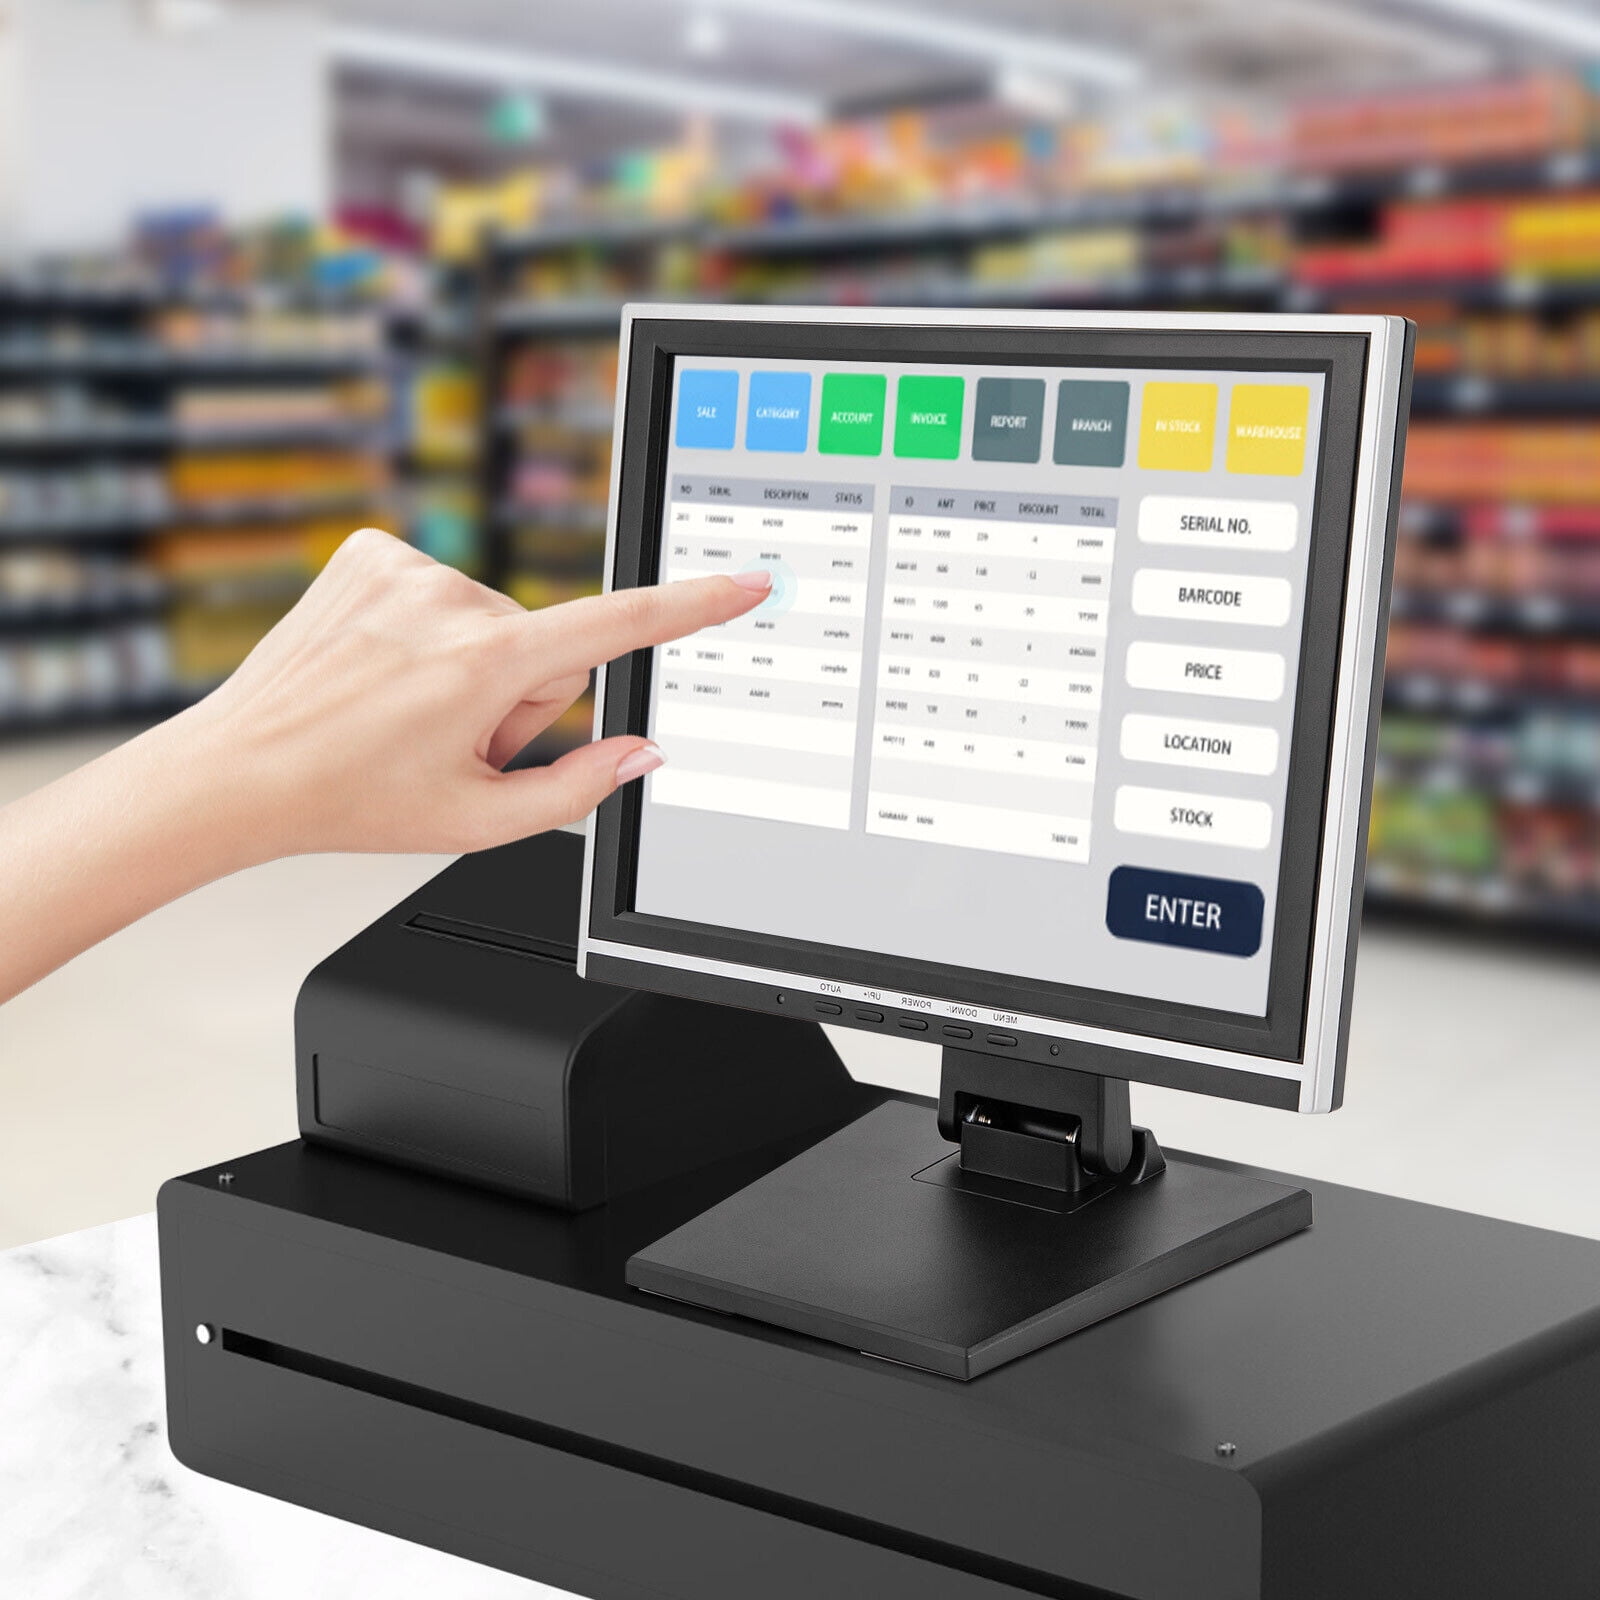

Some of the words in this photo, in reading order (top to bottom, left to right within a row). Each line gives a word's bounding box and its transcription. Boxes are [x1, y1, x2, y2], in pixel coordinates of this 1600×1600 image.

[697, 407, 716, 418] SALE
[756, 408, 799, 419] CATEGORY
[831, 412, 873, 424] ACCOUNT
[911, 413, 946, 424] INVOICE
[991, 416, 1027, 428] REPORT
[1072, 419, 1111, 431] BRANCH
[1236, 426, 1302, 440] WAREHOUSE
[681, 485, 692, 494] NO
[764, 489, 809, 500] DESCRIPTION
[835, 492, 862, 504] STATUS
[938, 499, 954, 508] AMT
[974, 501, 995, 512] PRICE
[1019, 503, 1058, 515] DISCOUNT
[1081, 507, 1104, 517] TOTAL
[1181, 516, 1224, 532] SERIAL
[1228, 518, 1251, 534] NO.
[1179, 588, 1241, 606] BARCODE
[1185, 663, 1222, 680] PRICE
[1165, 735, 1231, 755] LOCATION
[1171, 808, 1212, 827] STOCK
[1146, 894, 1221, 929] ENTER
